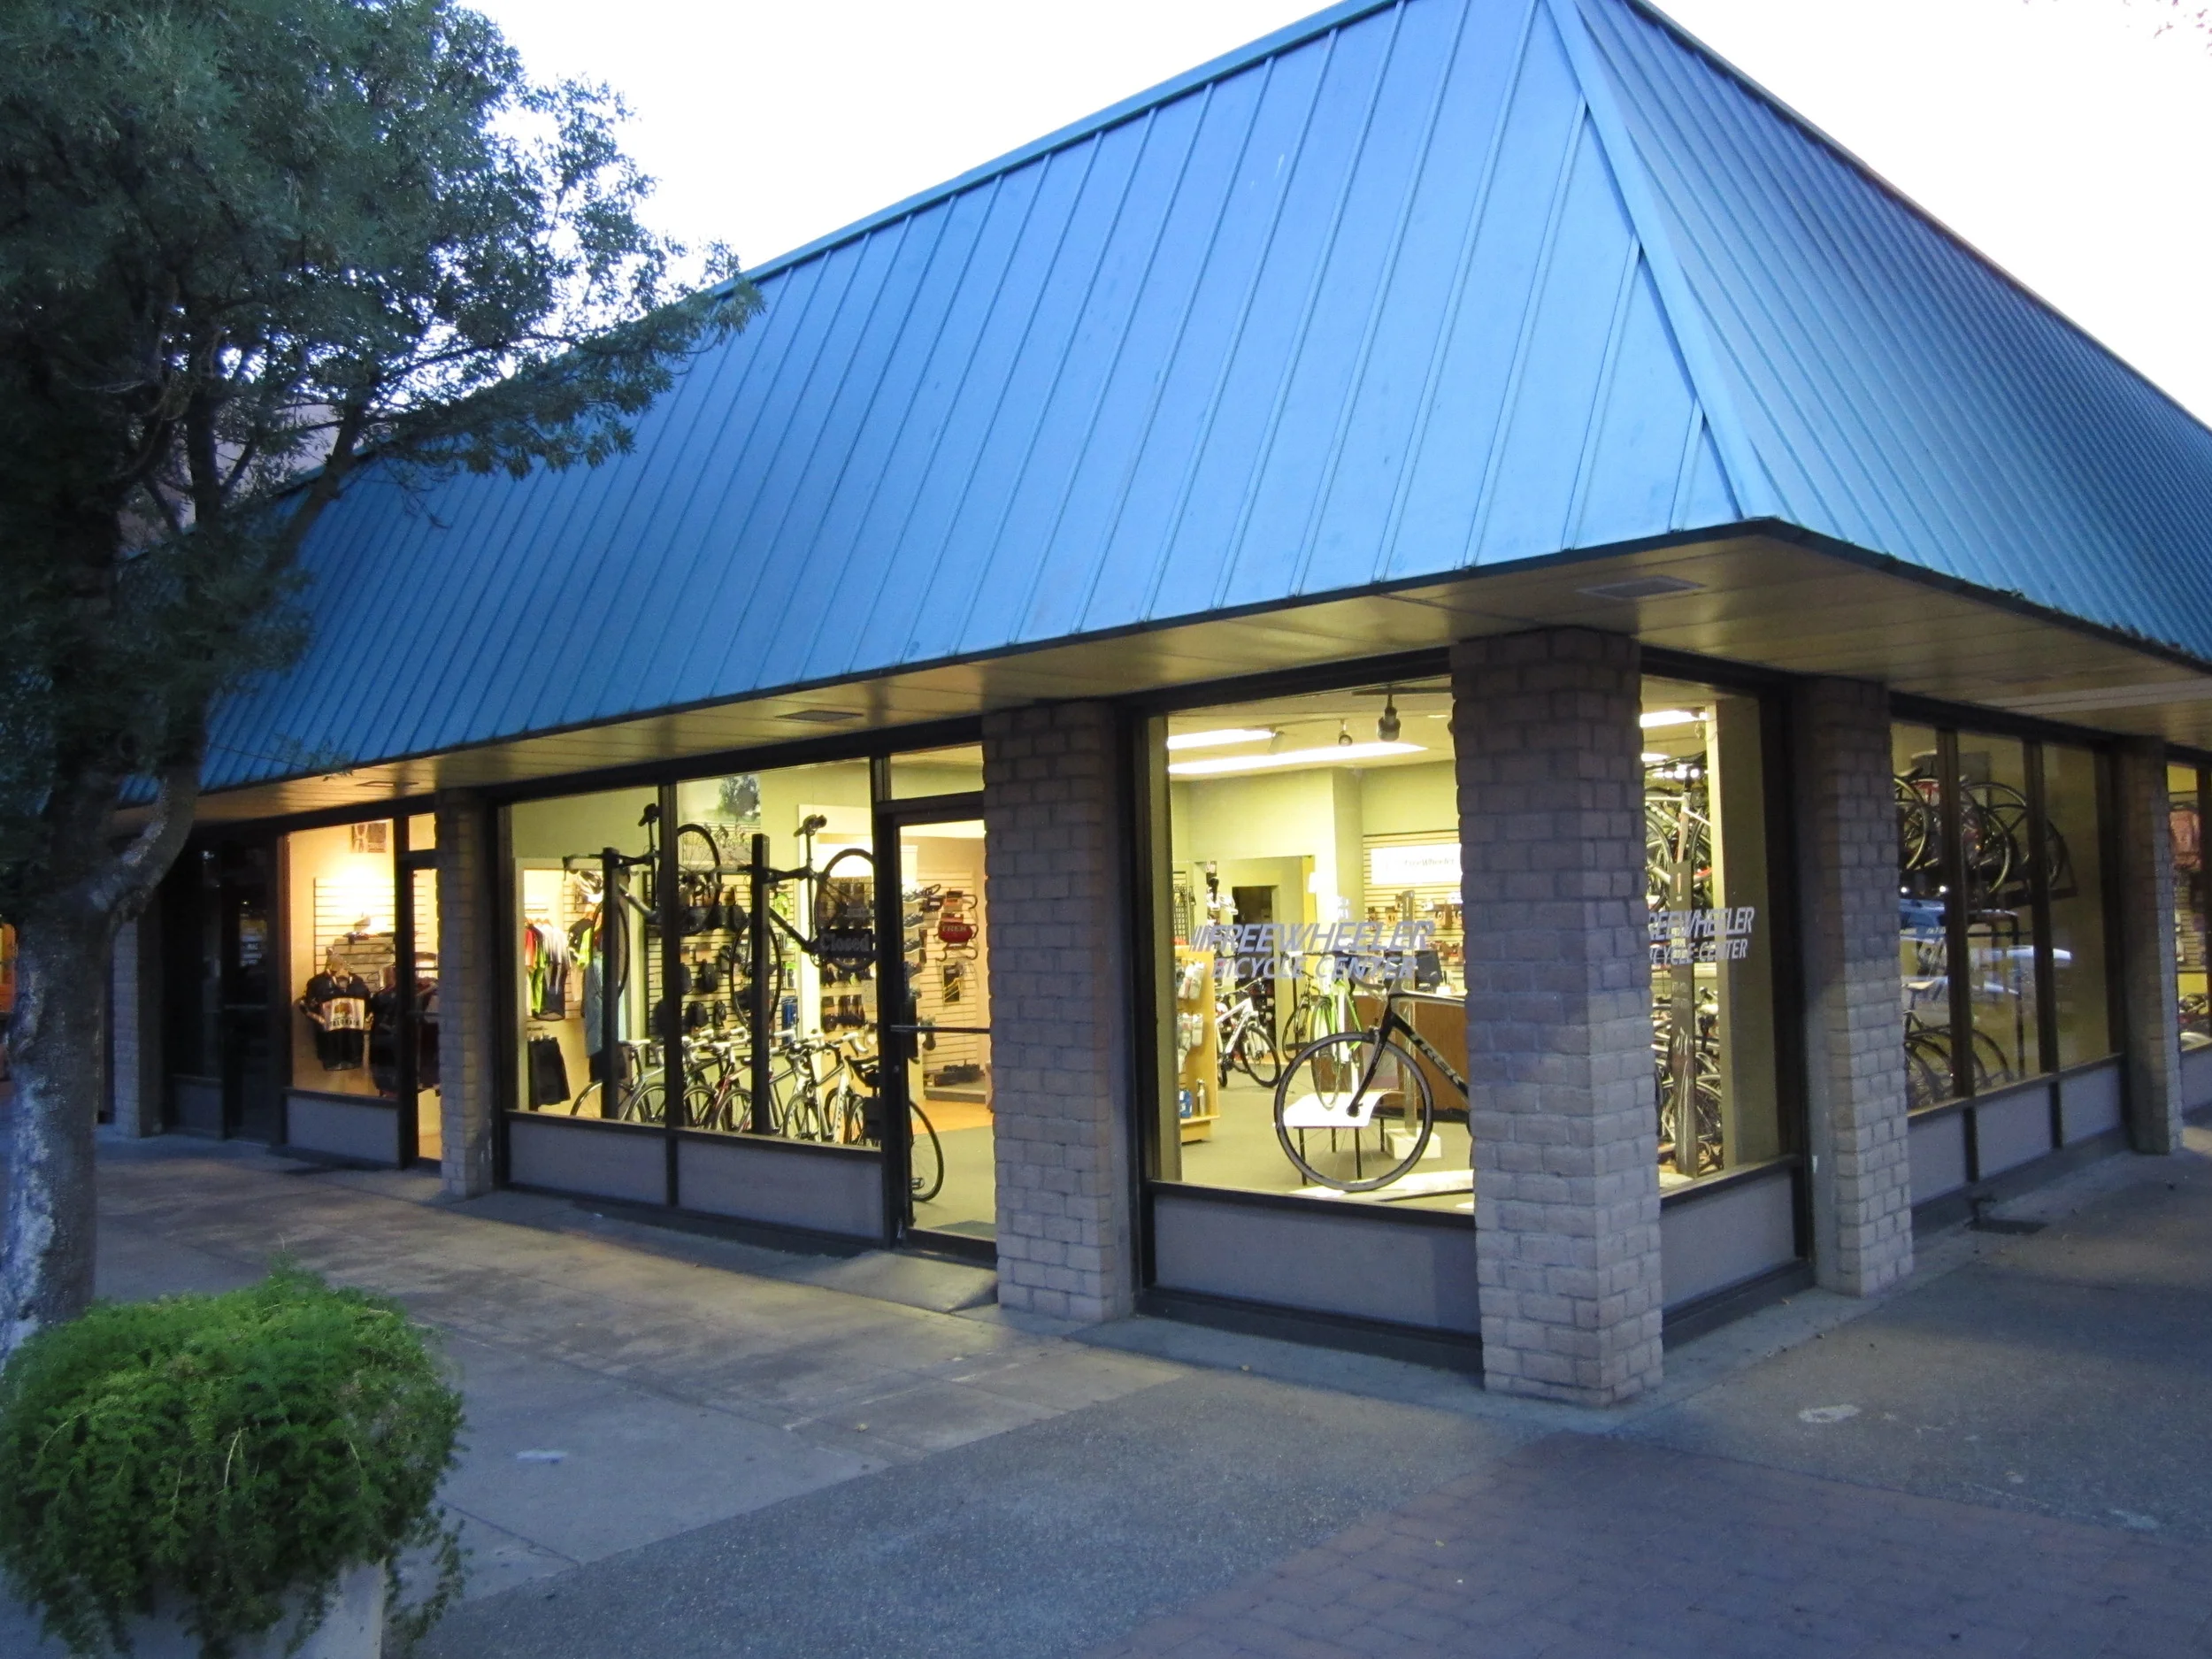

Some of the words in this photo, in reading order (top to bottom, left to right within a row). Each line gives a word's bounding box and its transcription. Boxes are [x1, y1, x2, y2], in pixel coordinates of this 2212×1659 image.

[819, 933, 871, 952] Closed
[1196, 920, 1434, 953] FREEWHEELER
[1699, 938, 1748, 962] CENTER
[1211, 956, 1307, 979] BICYCLE
[1314, 954, 1417, 979] CENTER
[1409, 1031, 1464, 1086] TREK
